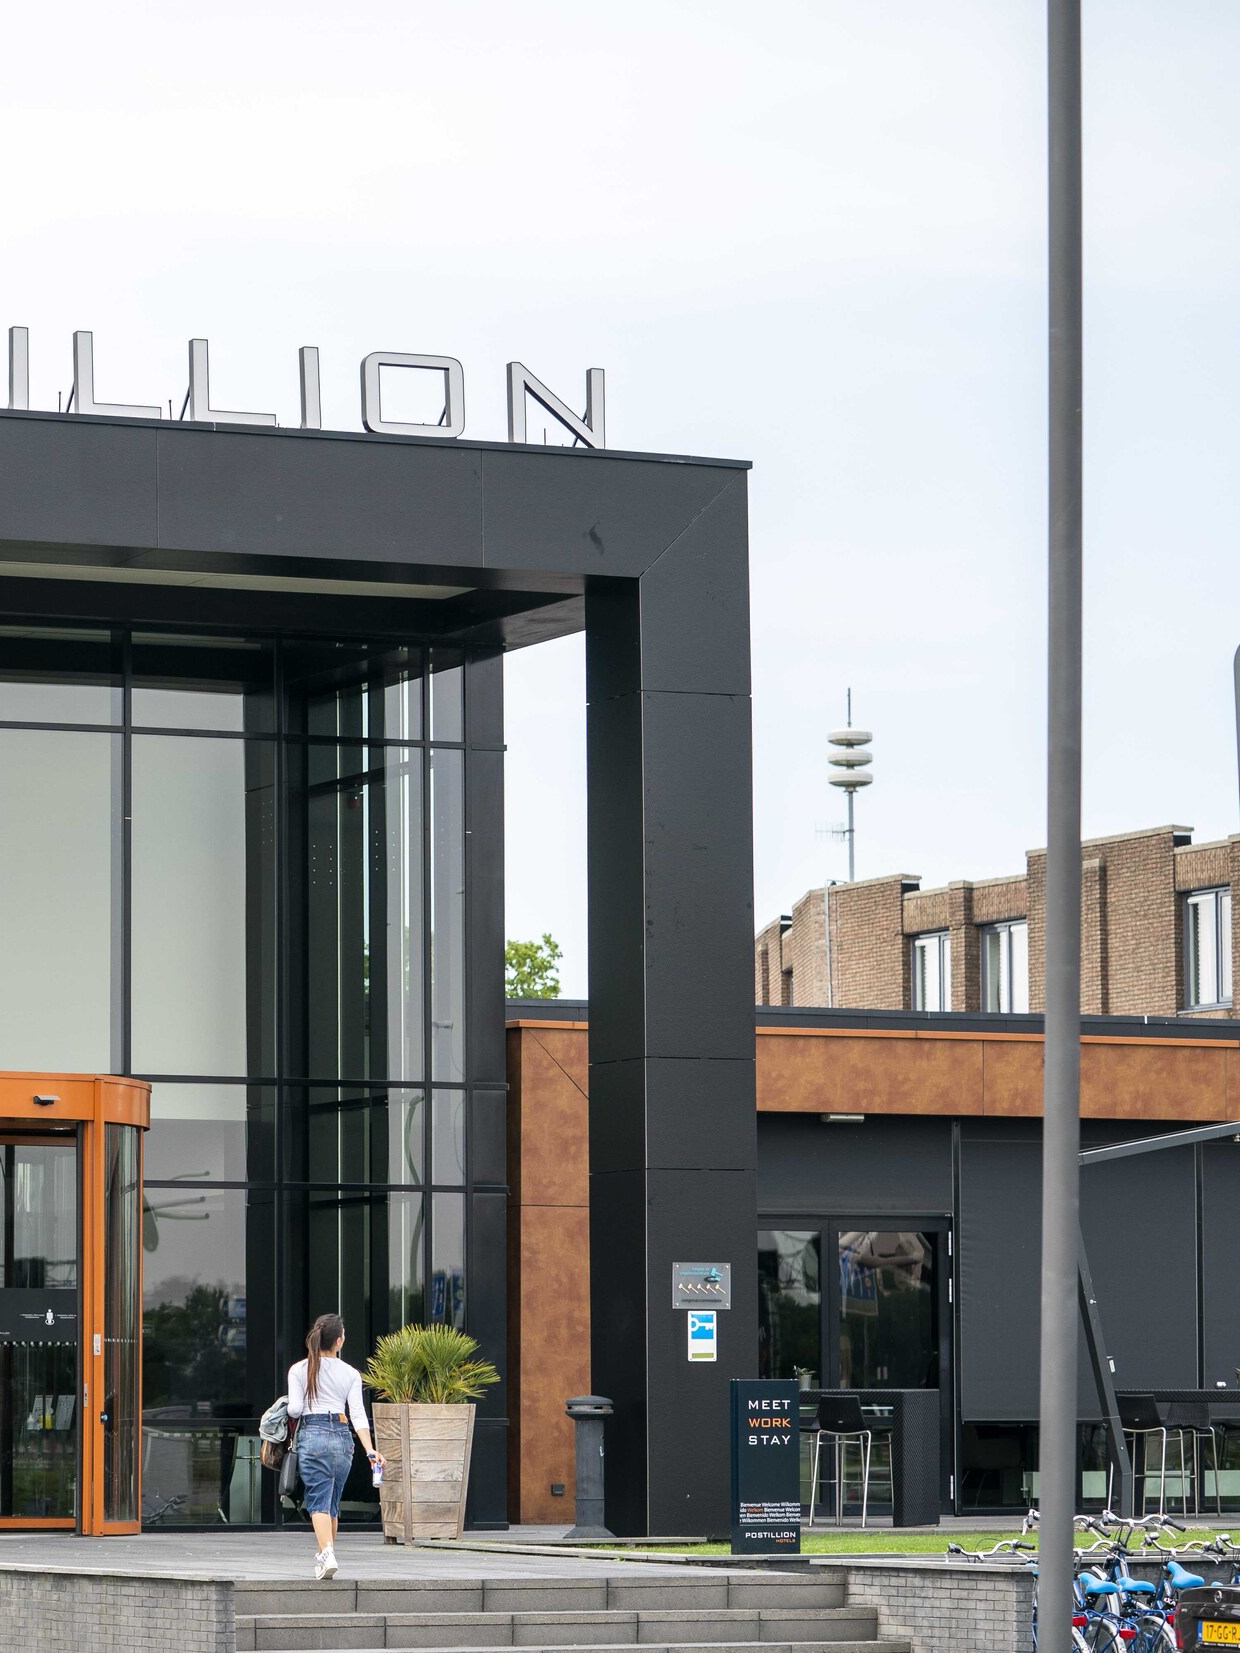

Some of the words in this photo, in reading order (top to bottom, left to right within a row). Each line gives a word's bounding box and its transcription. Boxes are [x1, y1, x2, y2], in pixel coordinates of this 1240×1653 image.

[748, 1400, 791, 1410] MEET
[748, 1418, 791, 1428] WORK
[748, 1435, 791, 1445] STAY
[1206, 1624, 1240, 1641] 17-GG-R
